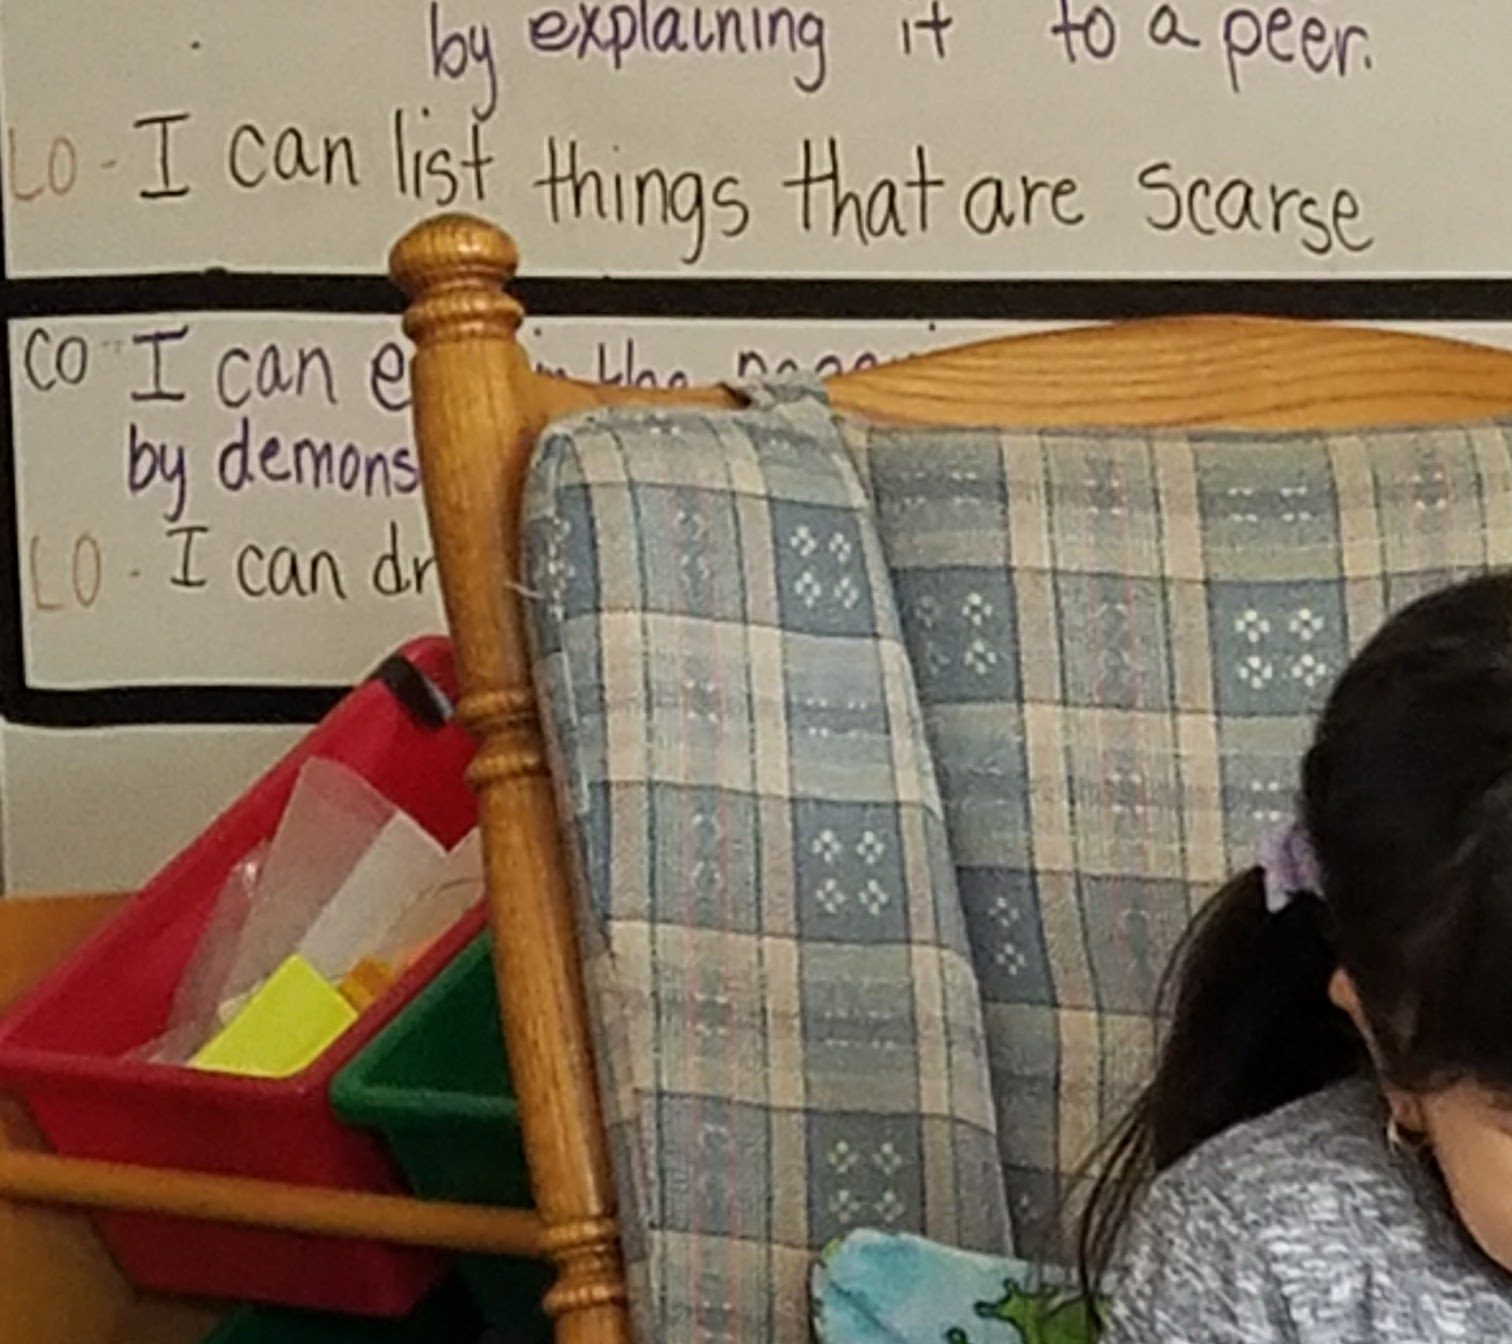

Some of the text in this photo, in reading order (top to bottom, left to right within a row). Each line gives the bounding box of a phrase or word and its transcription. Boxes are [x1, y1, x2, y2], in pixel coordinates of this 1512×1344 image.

[430, 0, 1374, 121] by explaining it to a peer.
[7, 126, 78, 202] LO
[133, 112, 192, 199] I
[228, 123, 362, 189] can
[394, 107, 495, 206] list
[532, 136, 750, 265] things
[782, 136, 946, 246] that
[964, 174, 1085, 235] are
[24, 327, 88, 392] CO
[130, 324, 190, 401] I
[216, 343, 338, 409] can
[128, 416, 187, 523] by
[29, 532, 101, 612] LO
[165, 525, 209, 588] I
[236, 543, 347, 600] can
